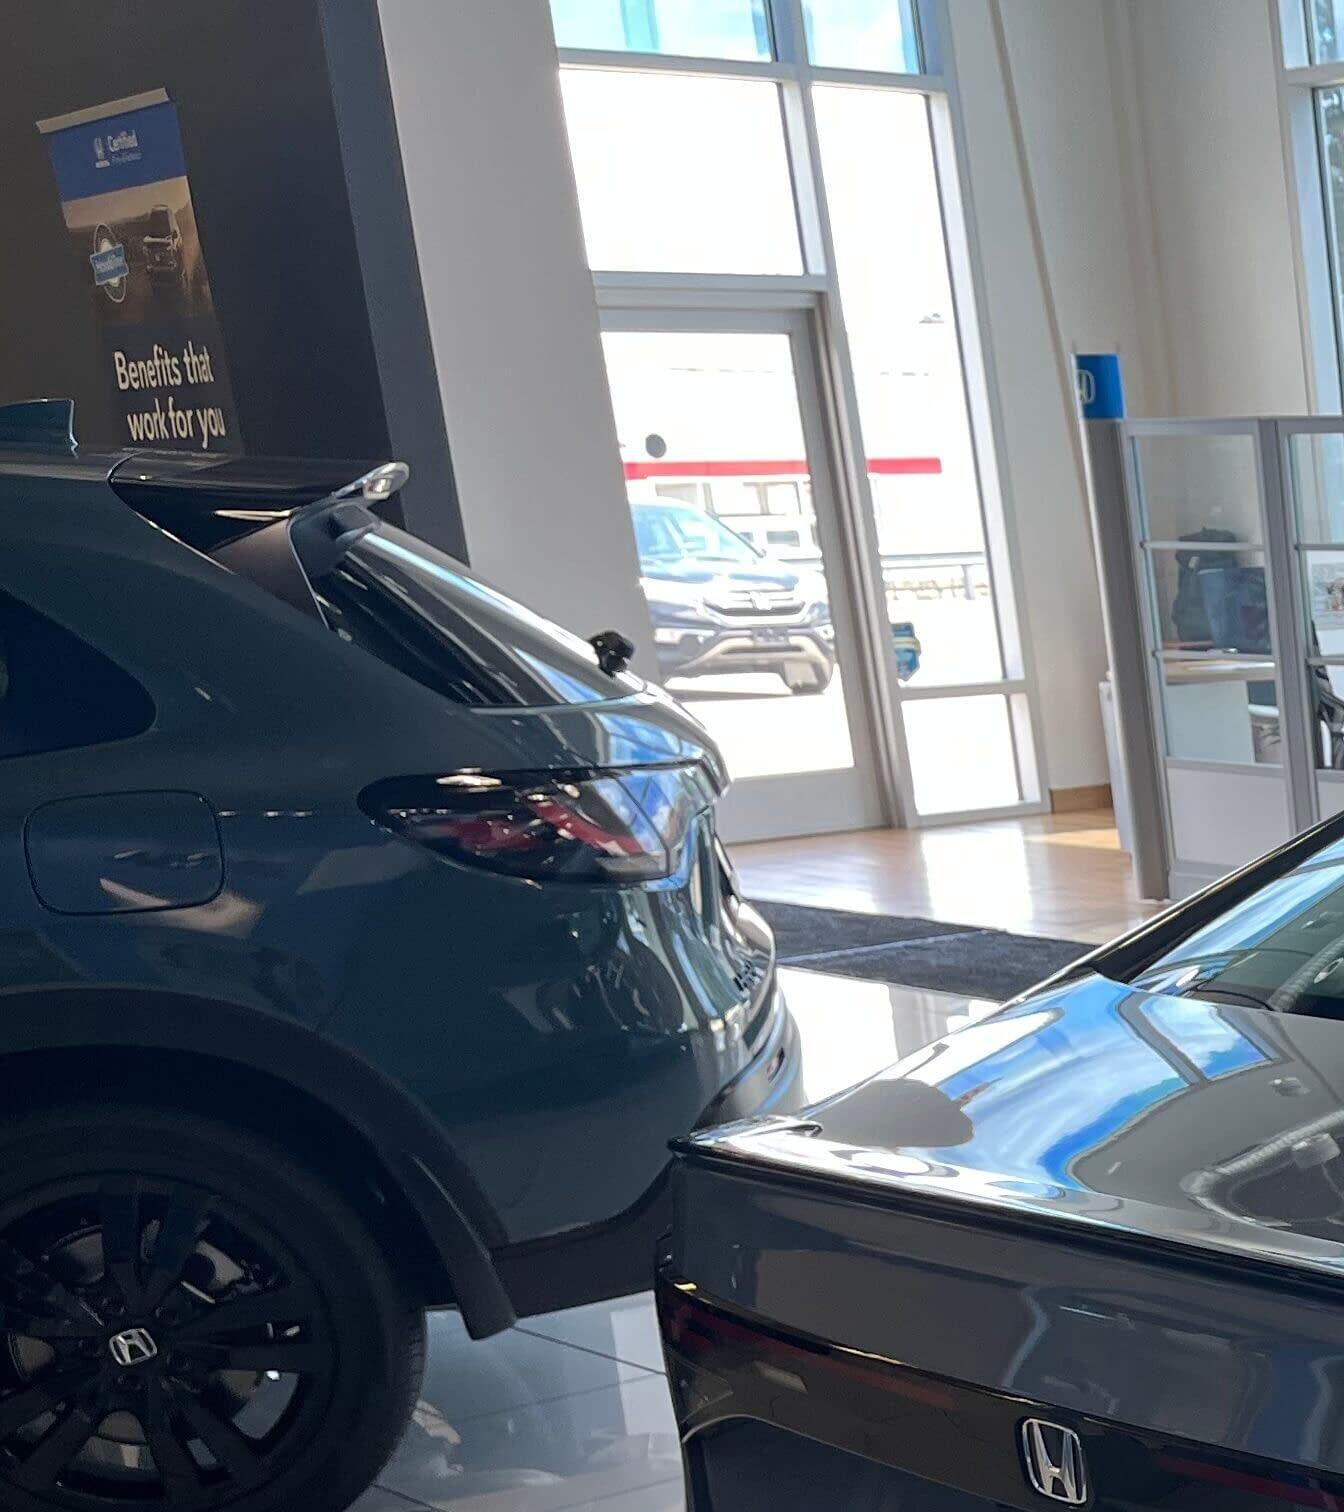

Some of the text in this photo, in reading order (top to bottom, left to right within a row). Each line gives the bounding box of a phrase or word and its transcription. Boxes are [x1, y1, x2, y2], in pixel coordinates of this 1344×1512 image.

[114, 340, 214, 390] Benefits that
[127, 396, 226, 449] work for you
